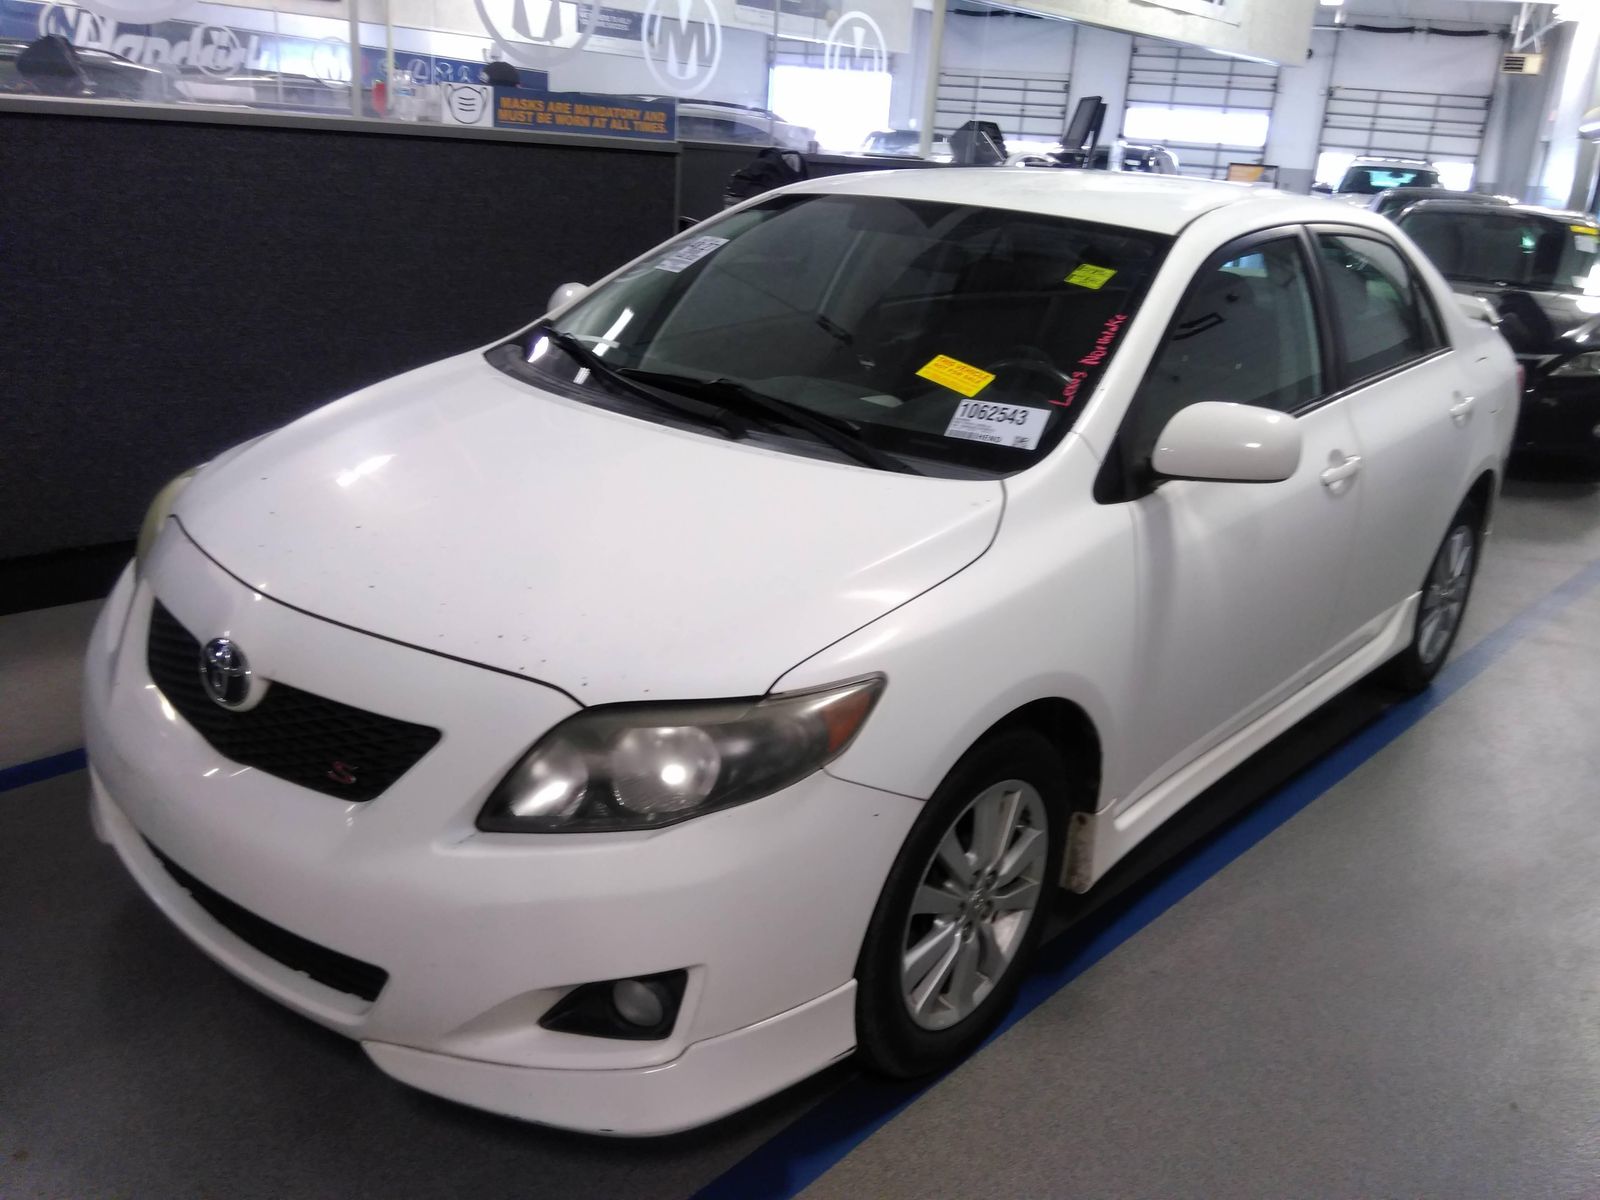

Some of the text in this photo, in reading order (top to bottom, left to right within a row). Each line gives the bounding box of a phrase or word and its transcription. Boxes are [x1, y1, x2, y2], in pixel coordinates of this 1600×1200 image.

[498, 109, 533, 122] MUST
[536, 112, 553, 124] BE
[555, 114, 590, 127] WORN
[592, 117, 608, 129] AT
[610, 118, 631, 131] ALL
[500, 96, 667, 123] MASKS ARE MANDATORY AND
[959, 403, 1029, 426] 1062543
[327, 760, 359, 784] S
